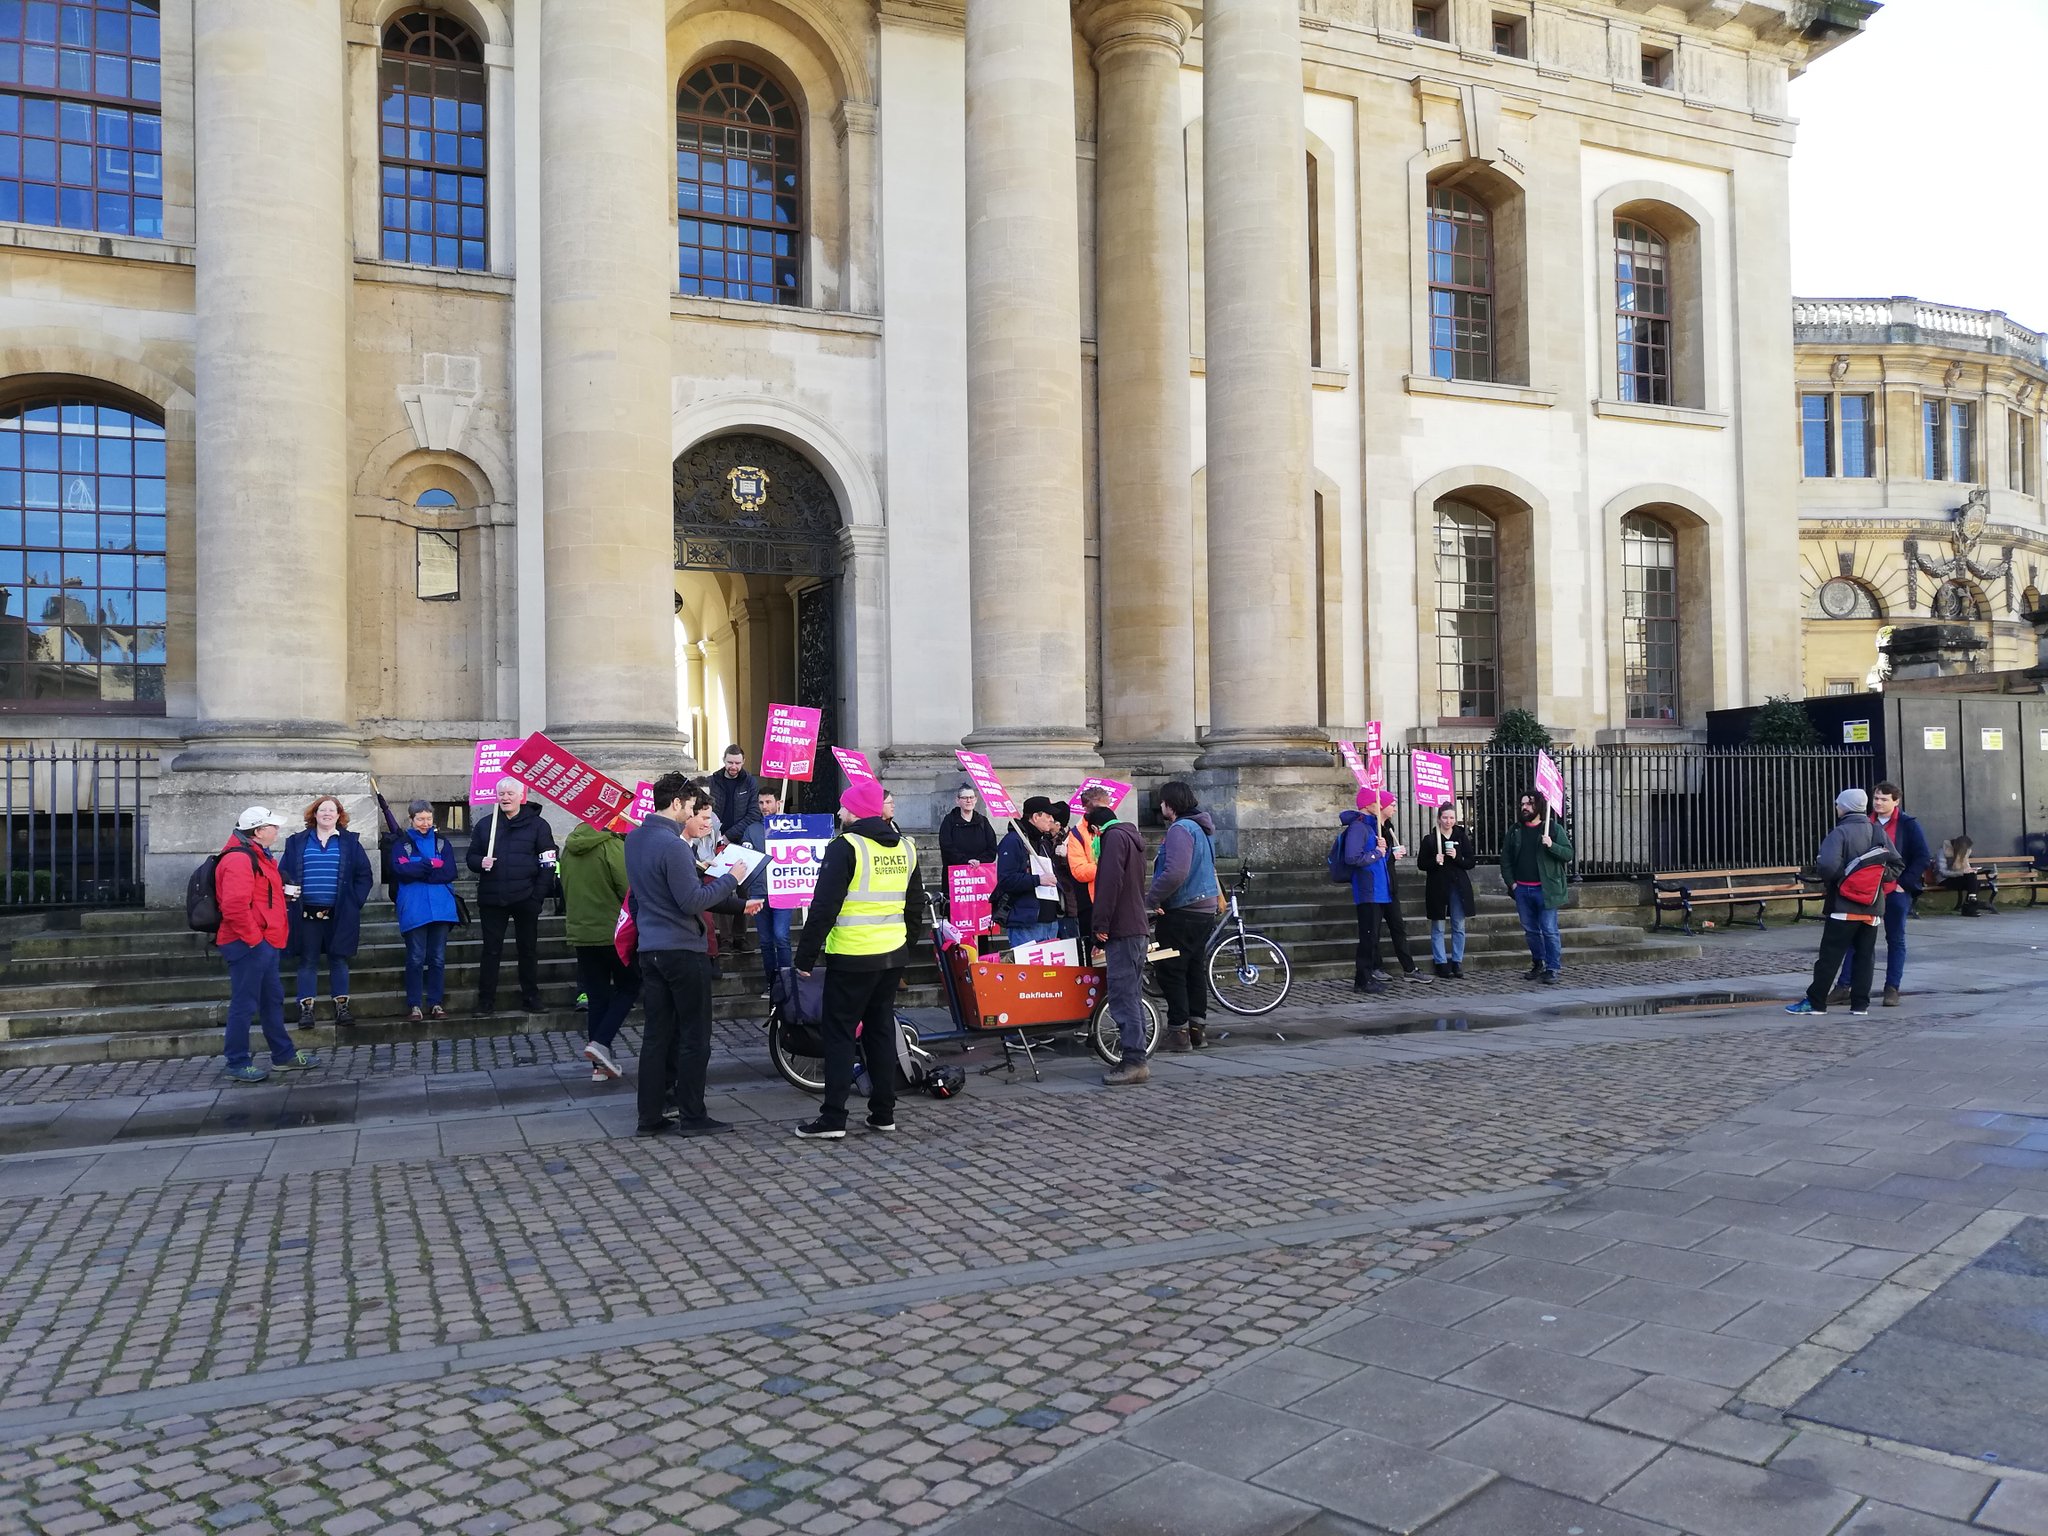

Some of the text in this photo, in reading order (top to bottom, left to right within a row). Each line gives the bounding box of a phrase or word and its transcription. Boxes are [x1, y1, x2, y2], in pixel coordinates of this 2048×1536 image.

[773, 709, 788, 717] ON
[773, 717, 807, 729] STRIKE
[771, 726, 791, 735] FOR
[769, 735, 812, 746] FAIR PAY
[481, 743, 497, 751] ON
[480, 750, 516, 759] STRIK
[1415, 753, 1428, 761] ON
[480, 758, 501, 767] FOR
[511, 759, 528, 774] ON
[523, 753, 555, 782] STRIKE
[766, 760, 784, 768] UCU
[1415, 760, 1443, 771] STRIKE
[1415, 766, 1428, 774] TO
[534, 762, 566, 789] TO WIN
[546, 763, 584, 798] BACK MY
[1416, 772, 1438, 781] BACK
[558, 771, 597, 805] PENSION
[1417, 779, 1450, 791] PENSION
[475, 788, 495, 796] UCU
[581, 804, 601, 819] UCU
[769, 818, 802, 831] UCU
[770, 845, 829, 865] UCU
[873, 855, 907, 867] PICKET
[874, 865, 908, 876] SUPERVISOR
[953, 869, 967, 877] ON
[772, 878, 819, 890] DISPU
[953, 876, 986, 886] STRIKE
[954, 886, 973, 894] FOR
[954, 894, 976, 903] FAIR
[1018, 991, 1063, 1000] Bakfiets.nl
